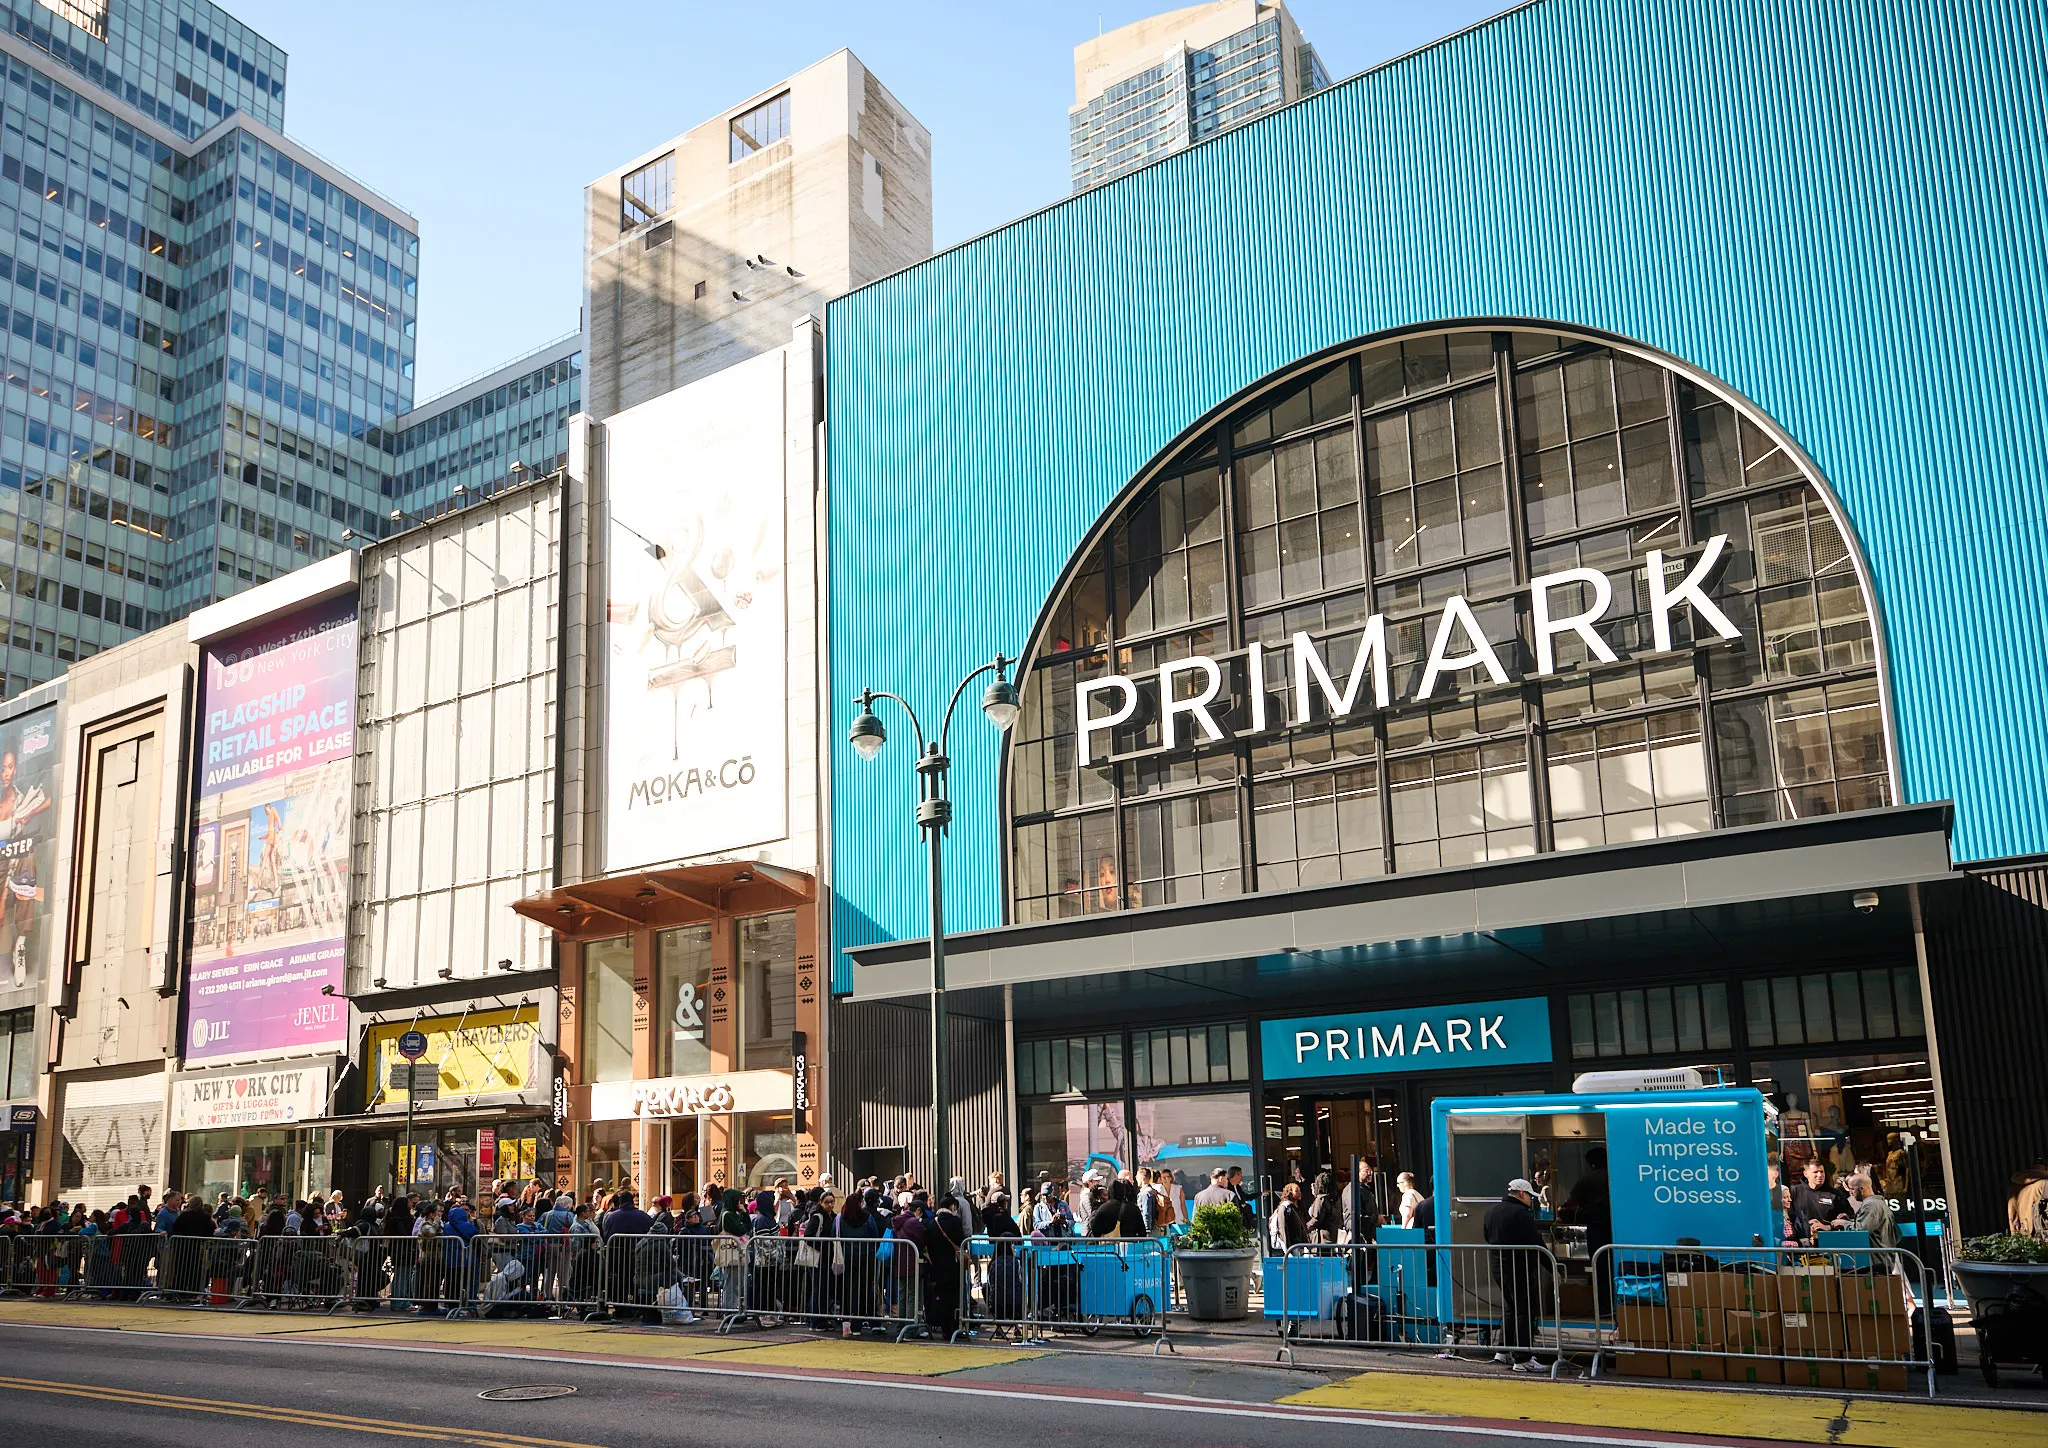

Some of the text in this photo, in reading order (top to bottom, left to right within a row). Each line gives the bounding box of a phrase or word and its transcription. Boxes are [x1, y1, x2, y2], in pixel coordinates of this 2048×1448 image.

[258, 613, 355, 659] West 34th Street
[1075, 534, 1743, 768] PRIMARK
[257, 630, 355, 675] New York City
[210, 683, 306, 735] FLAGSHIP
[208, 700, 348, 765] RETAIL SPACE
[206, 730, 352, 787] AVAILABLE FOR LEASE
[212, 966, 239, 979] SIEVERS
[244, 962, 260, 973] ERIN
[260, 957, 284, 970] GRACE
[289, 952, 317, 966] ARIANE
[317, 947, 345, 961] GIRARD
[294, 1003, 339, 1026] JENEL
[456, 1021, 530, 1048] TRAVELERS
[1294, 1014, 1508, 1065] PRIMARK
[193, 1080, 223, 1102] NEW
[270, 1072, 303, 1094] CITY
[213, 1102, 233, 1112] GIFTS
[243, 1098, 279, 1109] LUGGAGE
[70, 1114, 160, 1163] KAY
[1195, 1136, 1210, 1145] TAXI
[1644, 1117, 1736, 1135] Made to
[1648, 1139, 1738, 1160] Impress.
[1638, 1164, 1740, 1182] Priced to
[1654, 1185, 1742, 1204] Obsess.
[1906, 1198, 1947, 1212] KDS
